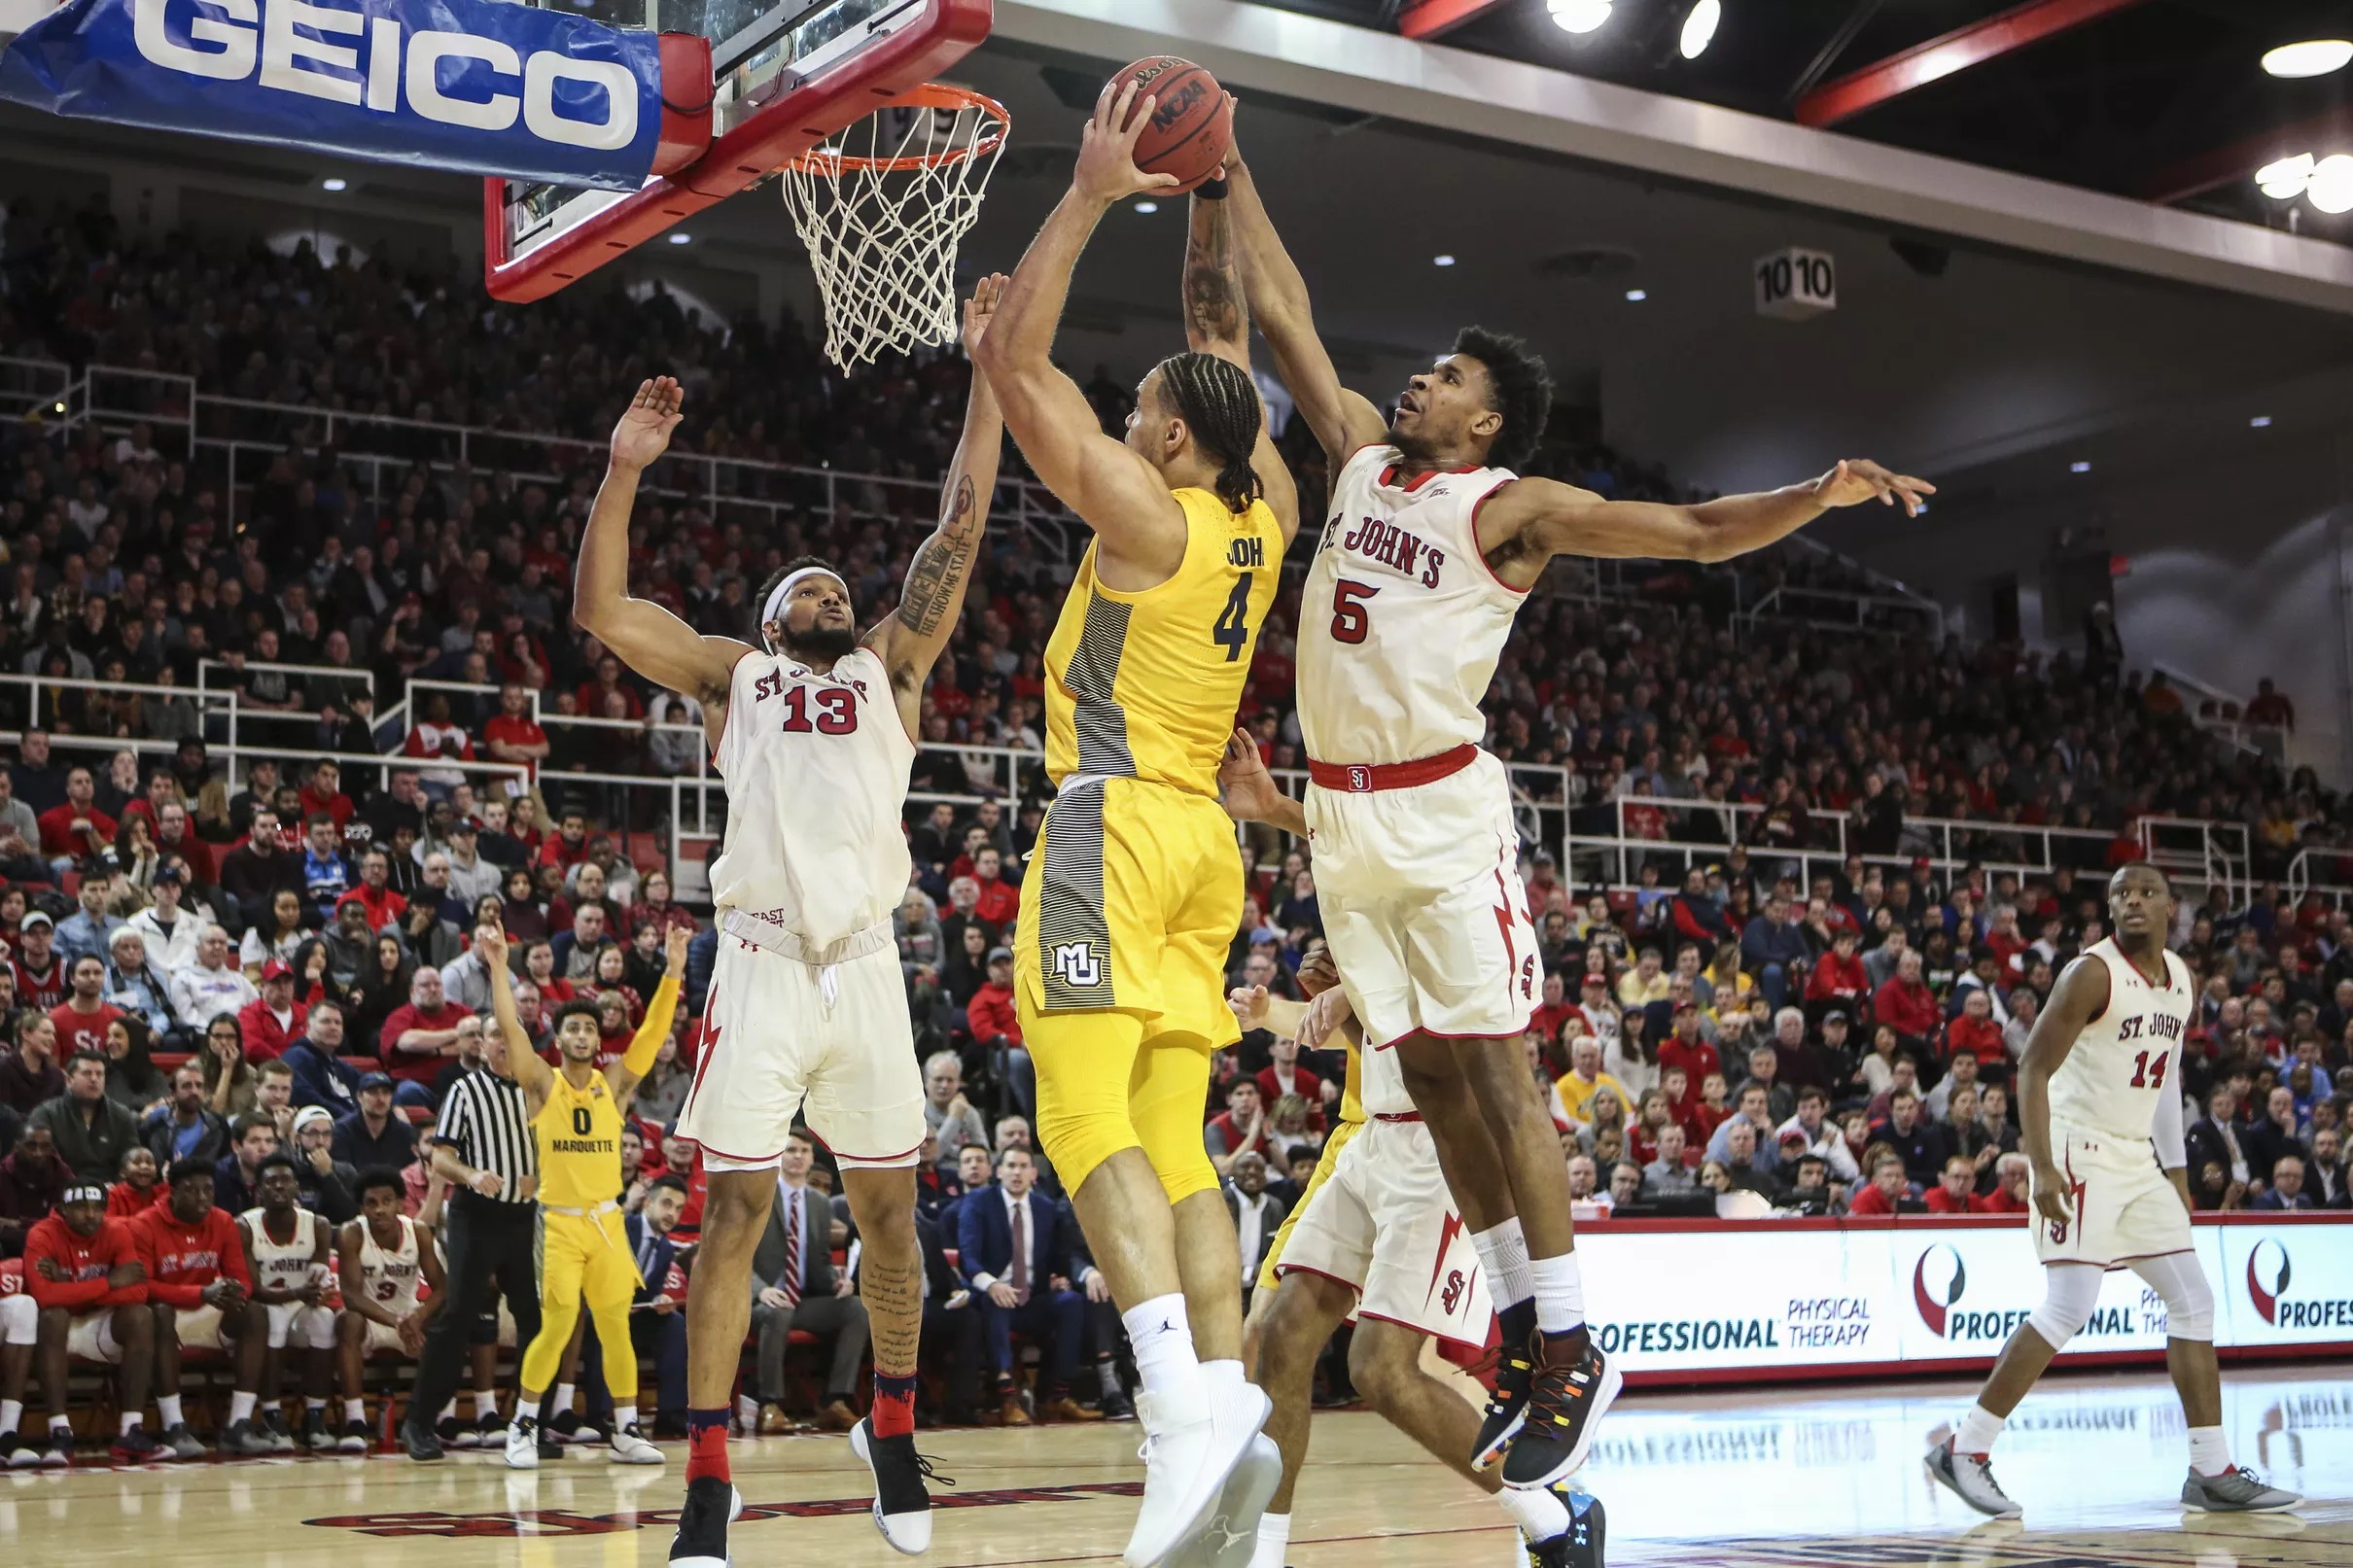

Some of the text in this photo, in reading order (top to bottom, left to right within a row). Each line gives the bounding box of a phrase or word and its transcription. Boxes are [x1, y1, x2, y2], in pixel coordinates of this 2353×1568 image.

[134, 0, 638, 151] GEICO
[1150, 79, 1208, 134] NCAA
[1757, 257, 1791, 303] 10
[1796, 256, 1832, 298] 10
[1227, 538, 1264, 567] JOH
[1345, 517, 1445, 589] JOHN'S
[919, 614, 939, 638] THE
[931, 580, 955, 616] SHOW
[1213, 572, 1248, 662] 4
[1330, 578, 1382, 645] 5
[783, 685, 858, 735] 13
[1051, 942, 1103, 988] MU
[2118, 1015, 2143, 1041] ST.
[2129, 1051, 2168, 1089] 14
[573, 1107, 591, 1135] 0
[552, 1139, 614, 1153] MARQUETTE
[1788, 1298, 1871, 1320] PHYSICAL
[1589, 1319, 1779, 1353] OFESSIONAL
[1789, 1324, 1870, 1347] THERAPY
